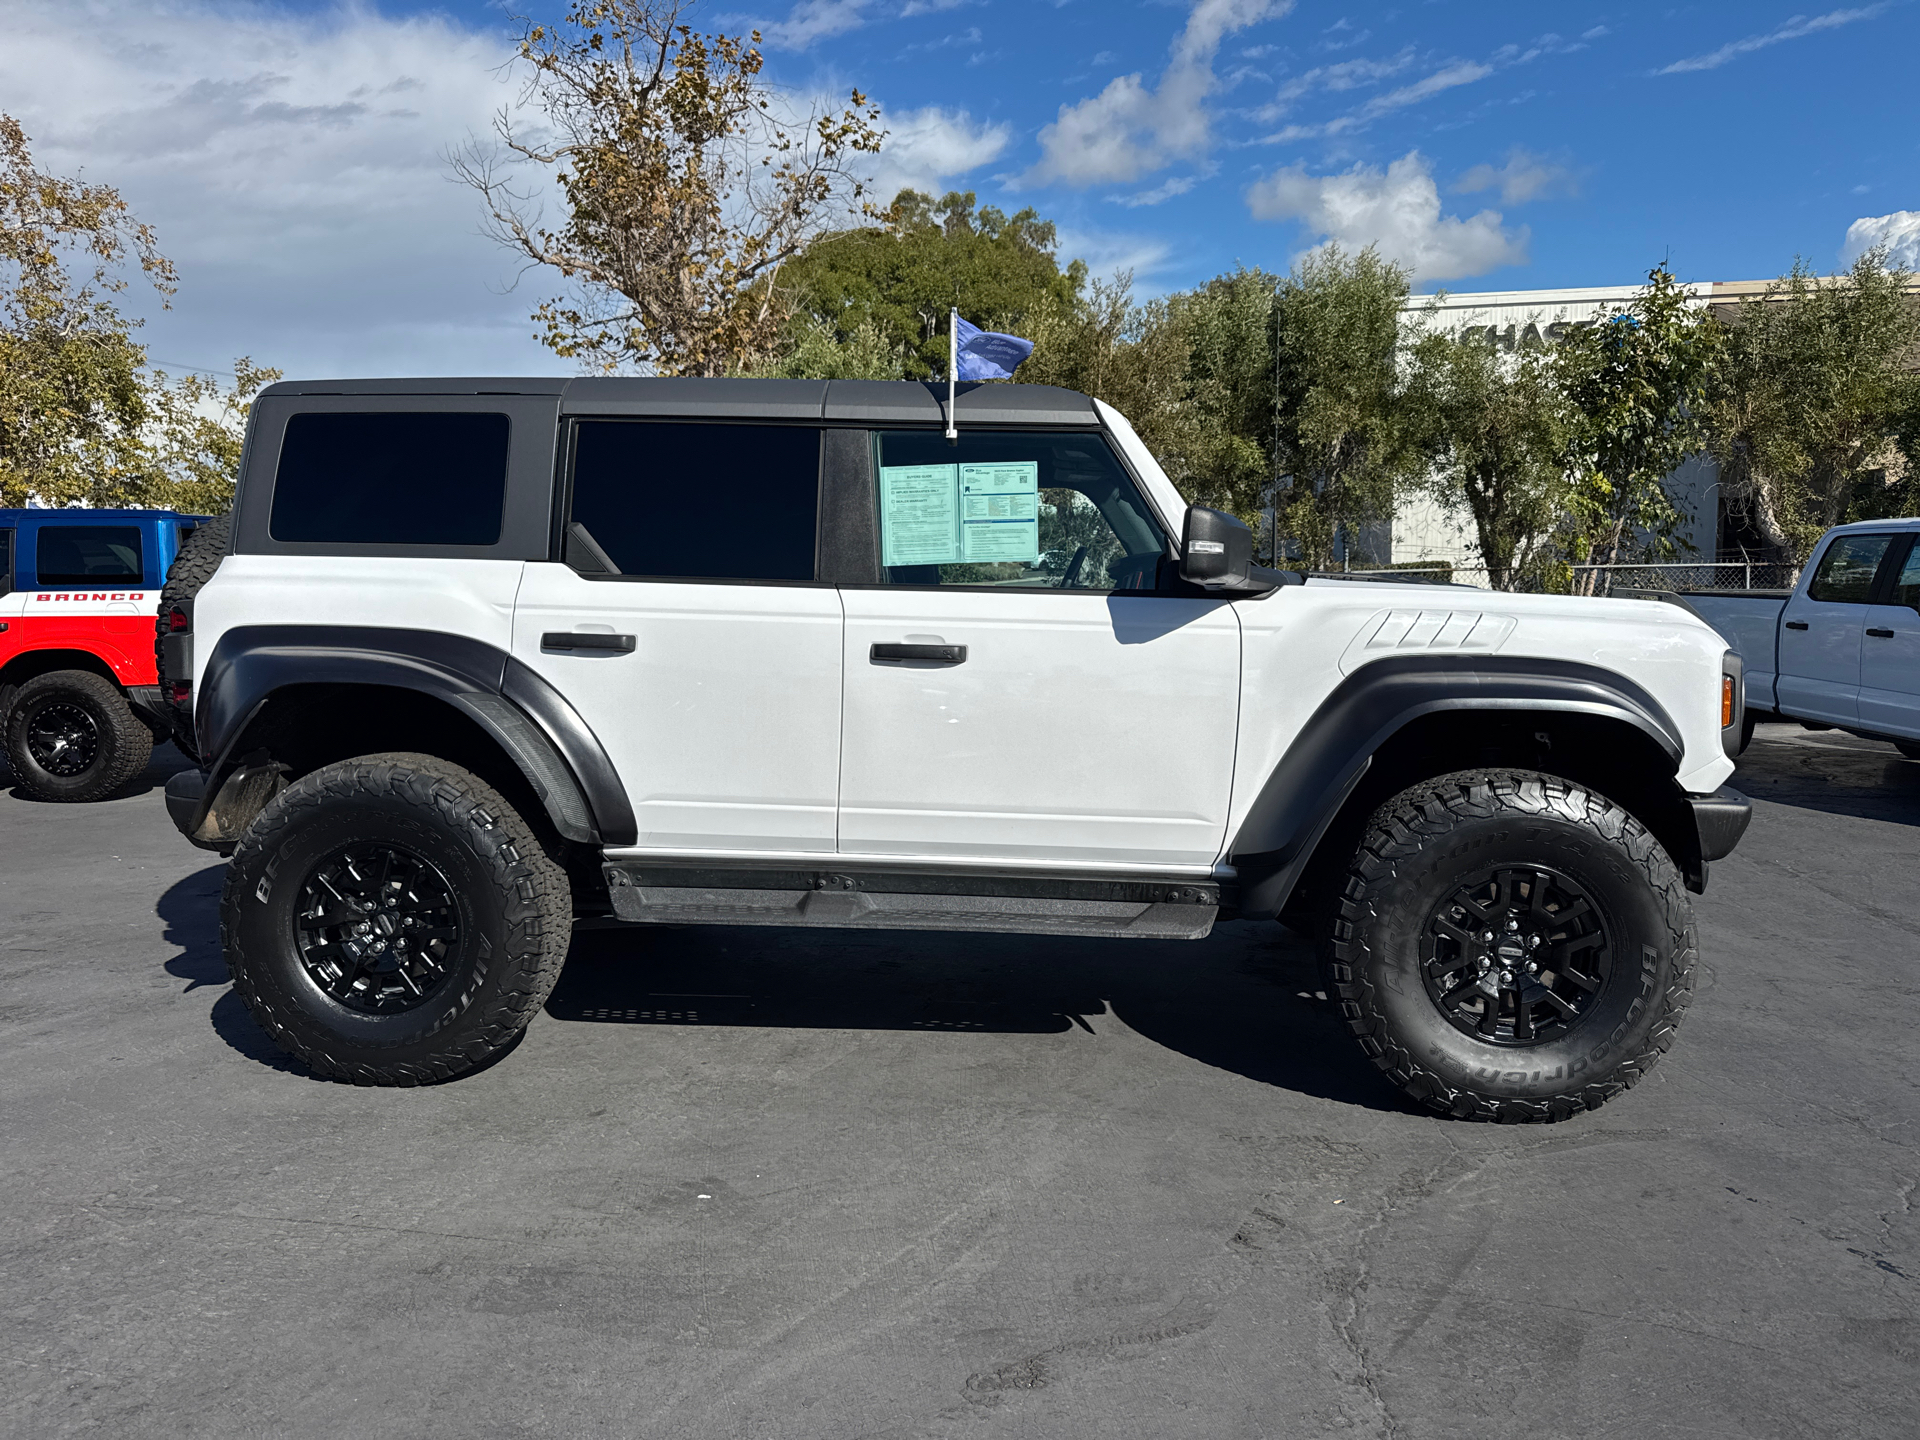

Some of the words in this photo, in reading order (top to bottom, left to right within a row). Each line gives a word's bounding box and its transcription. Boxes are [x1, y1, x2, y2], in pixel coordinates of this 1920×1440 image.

[1460, 320, 1598, 354] CHAS
[36, 593, 144, 602] BRONCO
[1474, 943, 1659, 1088] BFGoodrich
